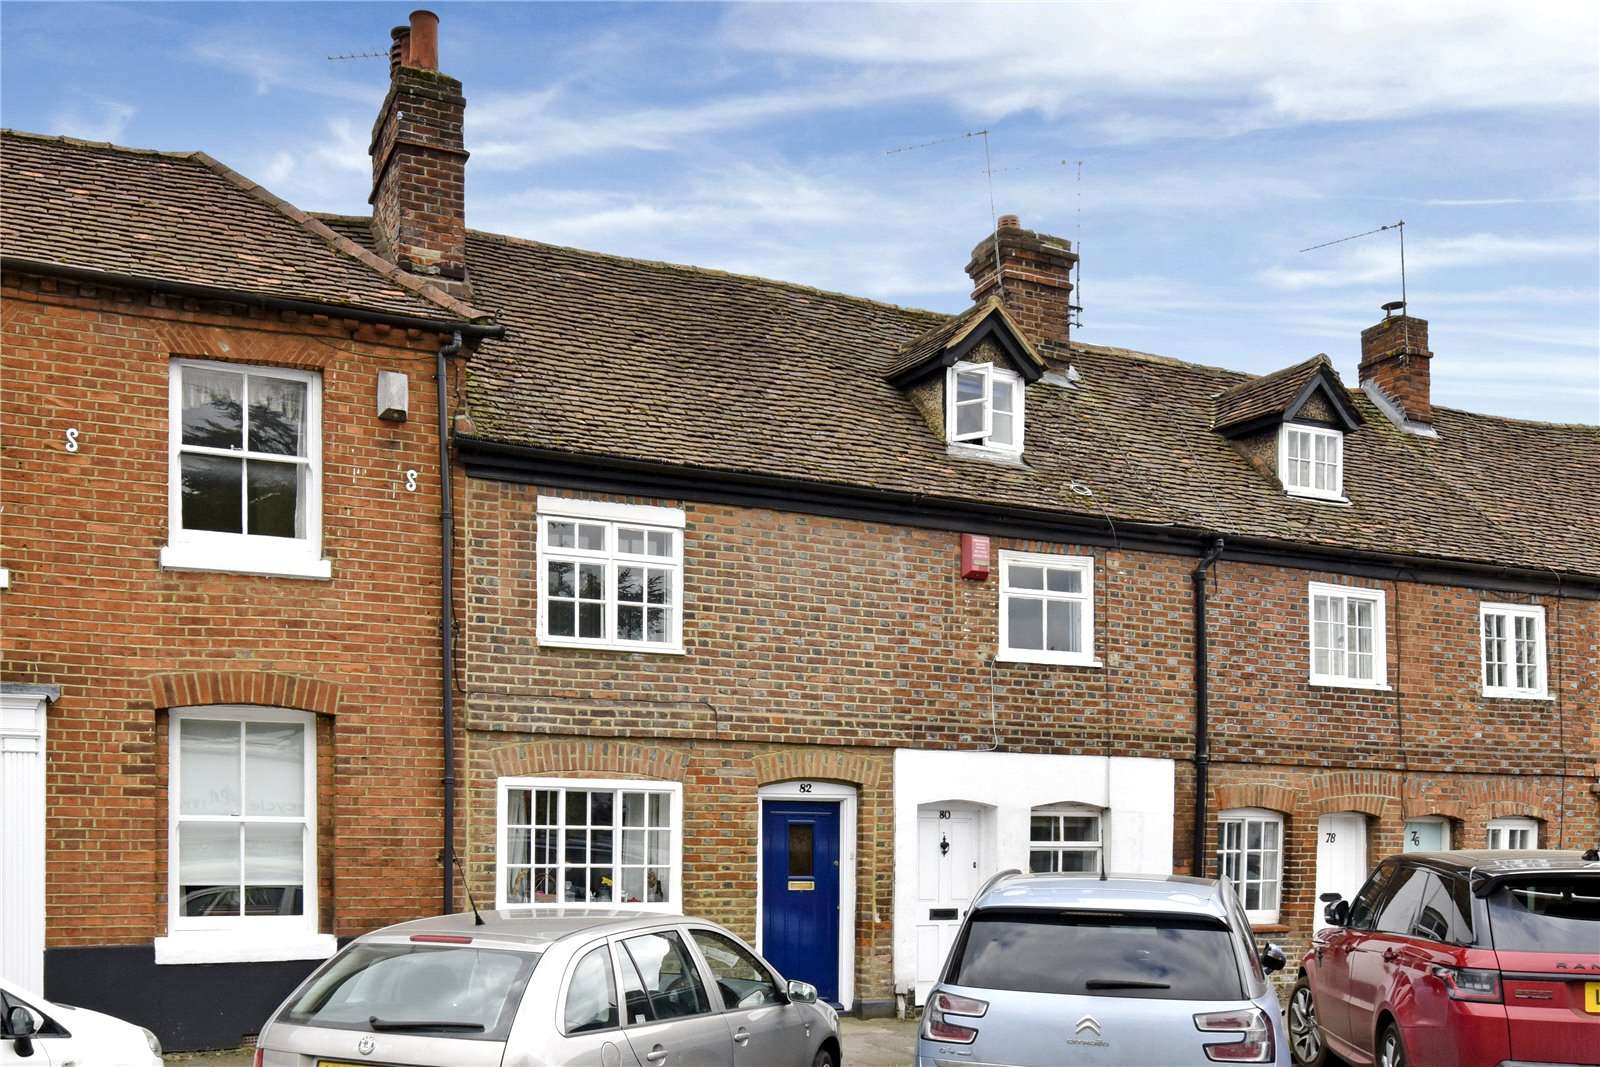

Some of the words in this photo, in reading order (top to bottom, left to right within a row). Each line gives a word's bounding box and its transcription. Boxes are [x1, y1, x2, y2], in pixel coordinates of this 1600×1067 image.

[800, 783, 812, 793] 82
[939, 810, 951, 820] 80
[1325, 832, 1336, 843] 78
[1411, 831, 1420, 847] 76
